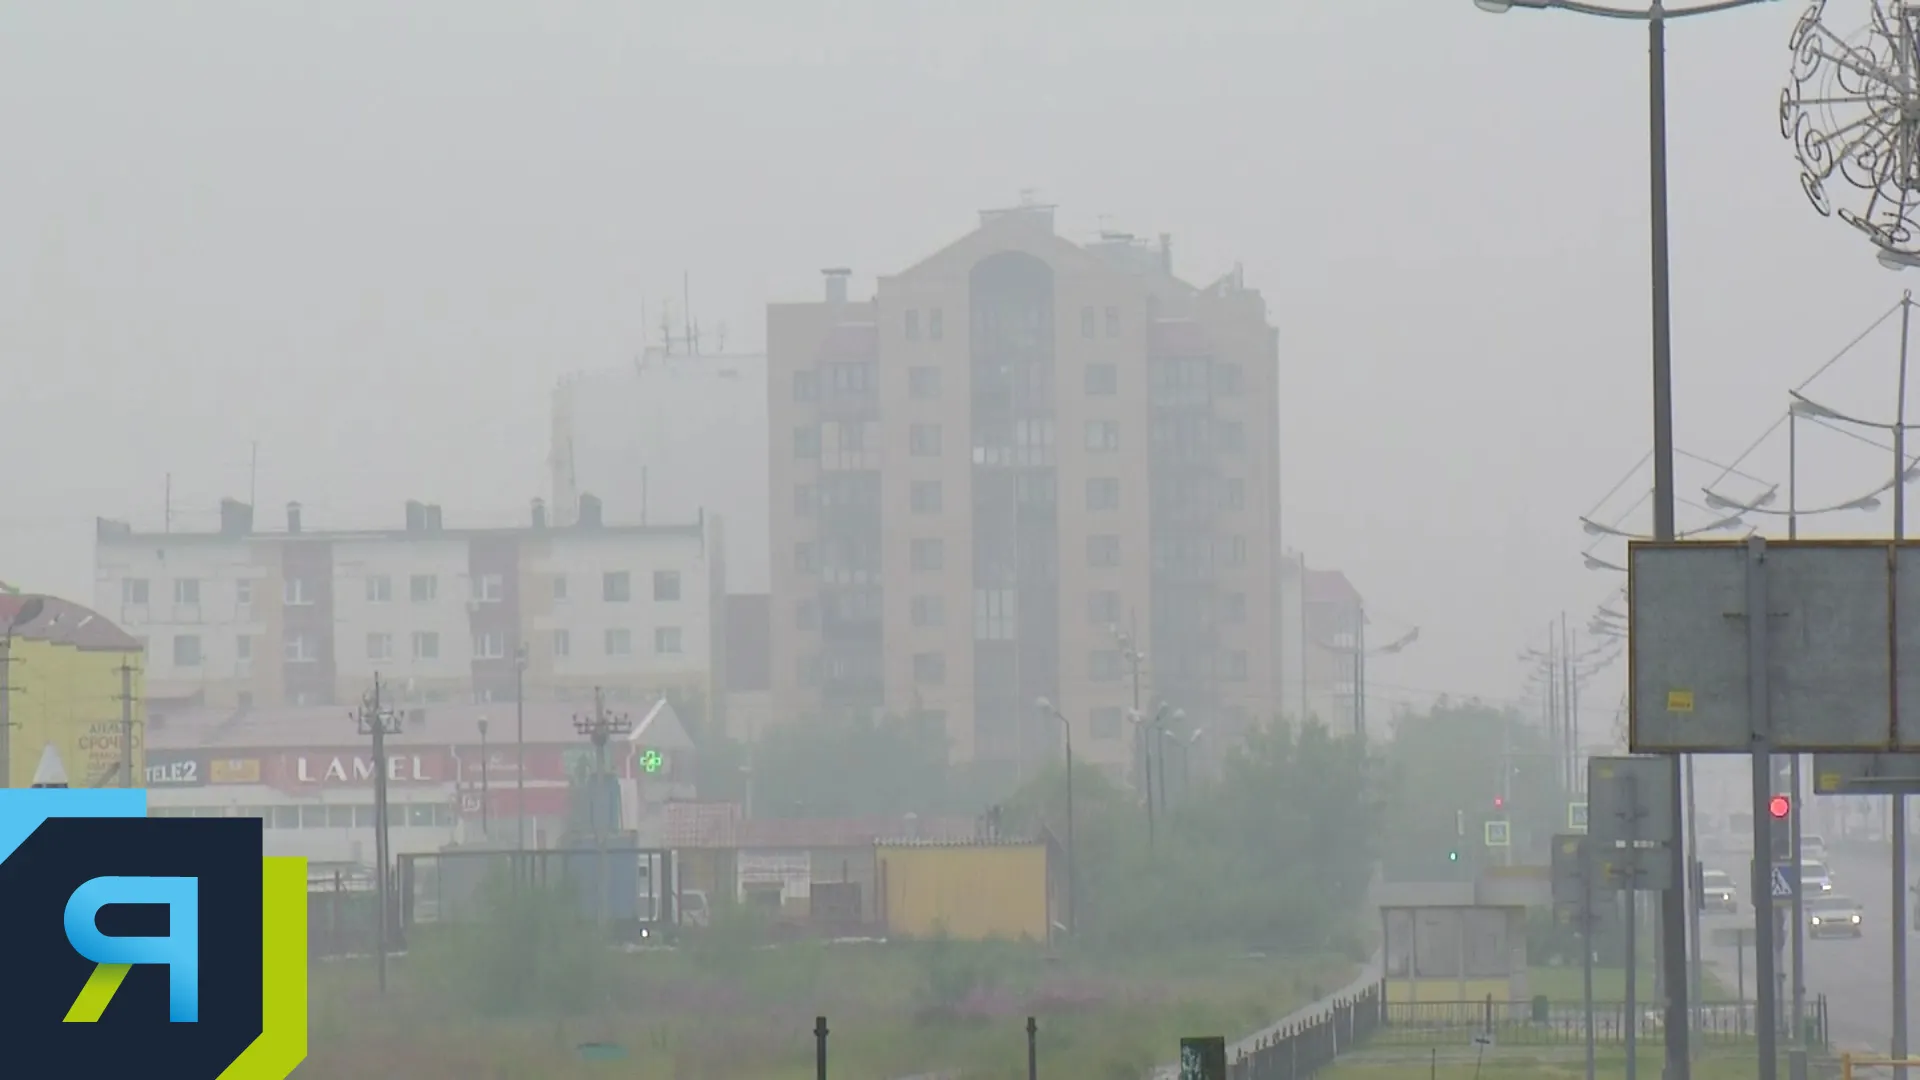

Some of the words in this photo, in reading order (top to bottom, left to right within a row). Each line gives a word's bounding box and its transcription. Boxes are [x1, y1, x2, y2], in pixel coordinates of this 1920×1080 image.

[79, 735, 139, 750] СРОЧО
[144, 760, 198, 782] TELE2
[298, 756, 432, 782] LAMEL
